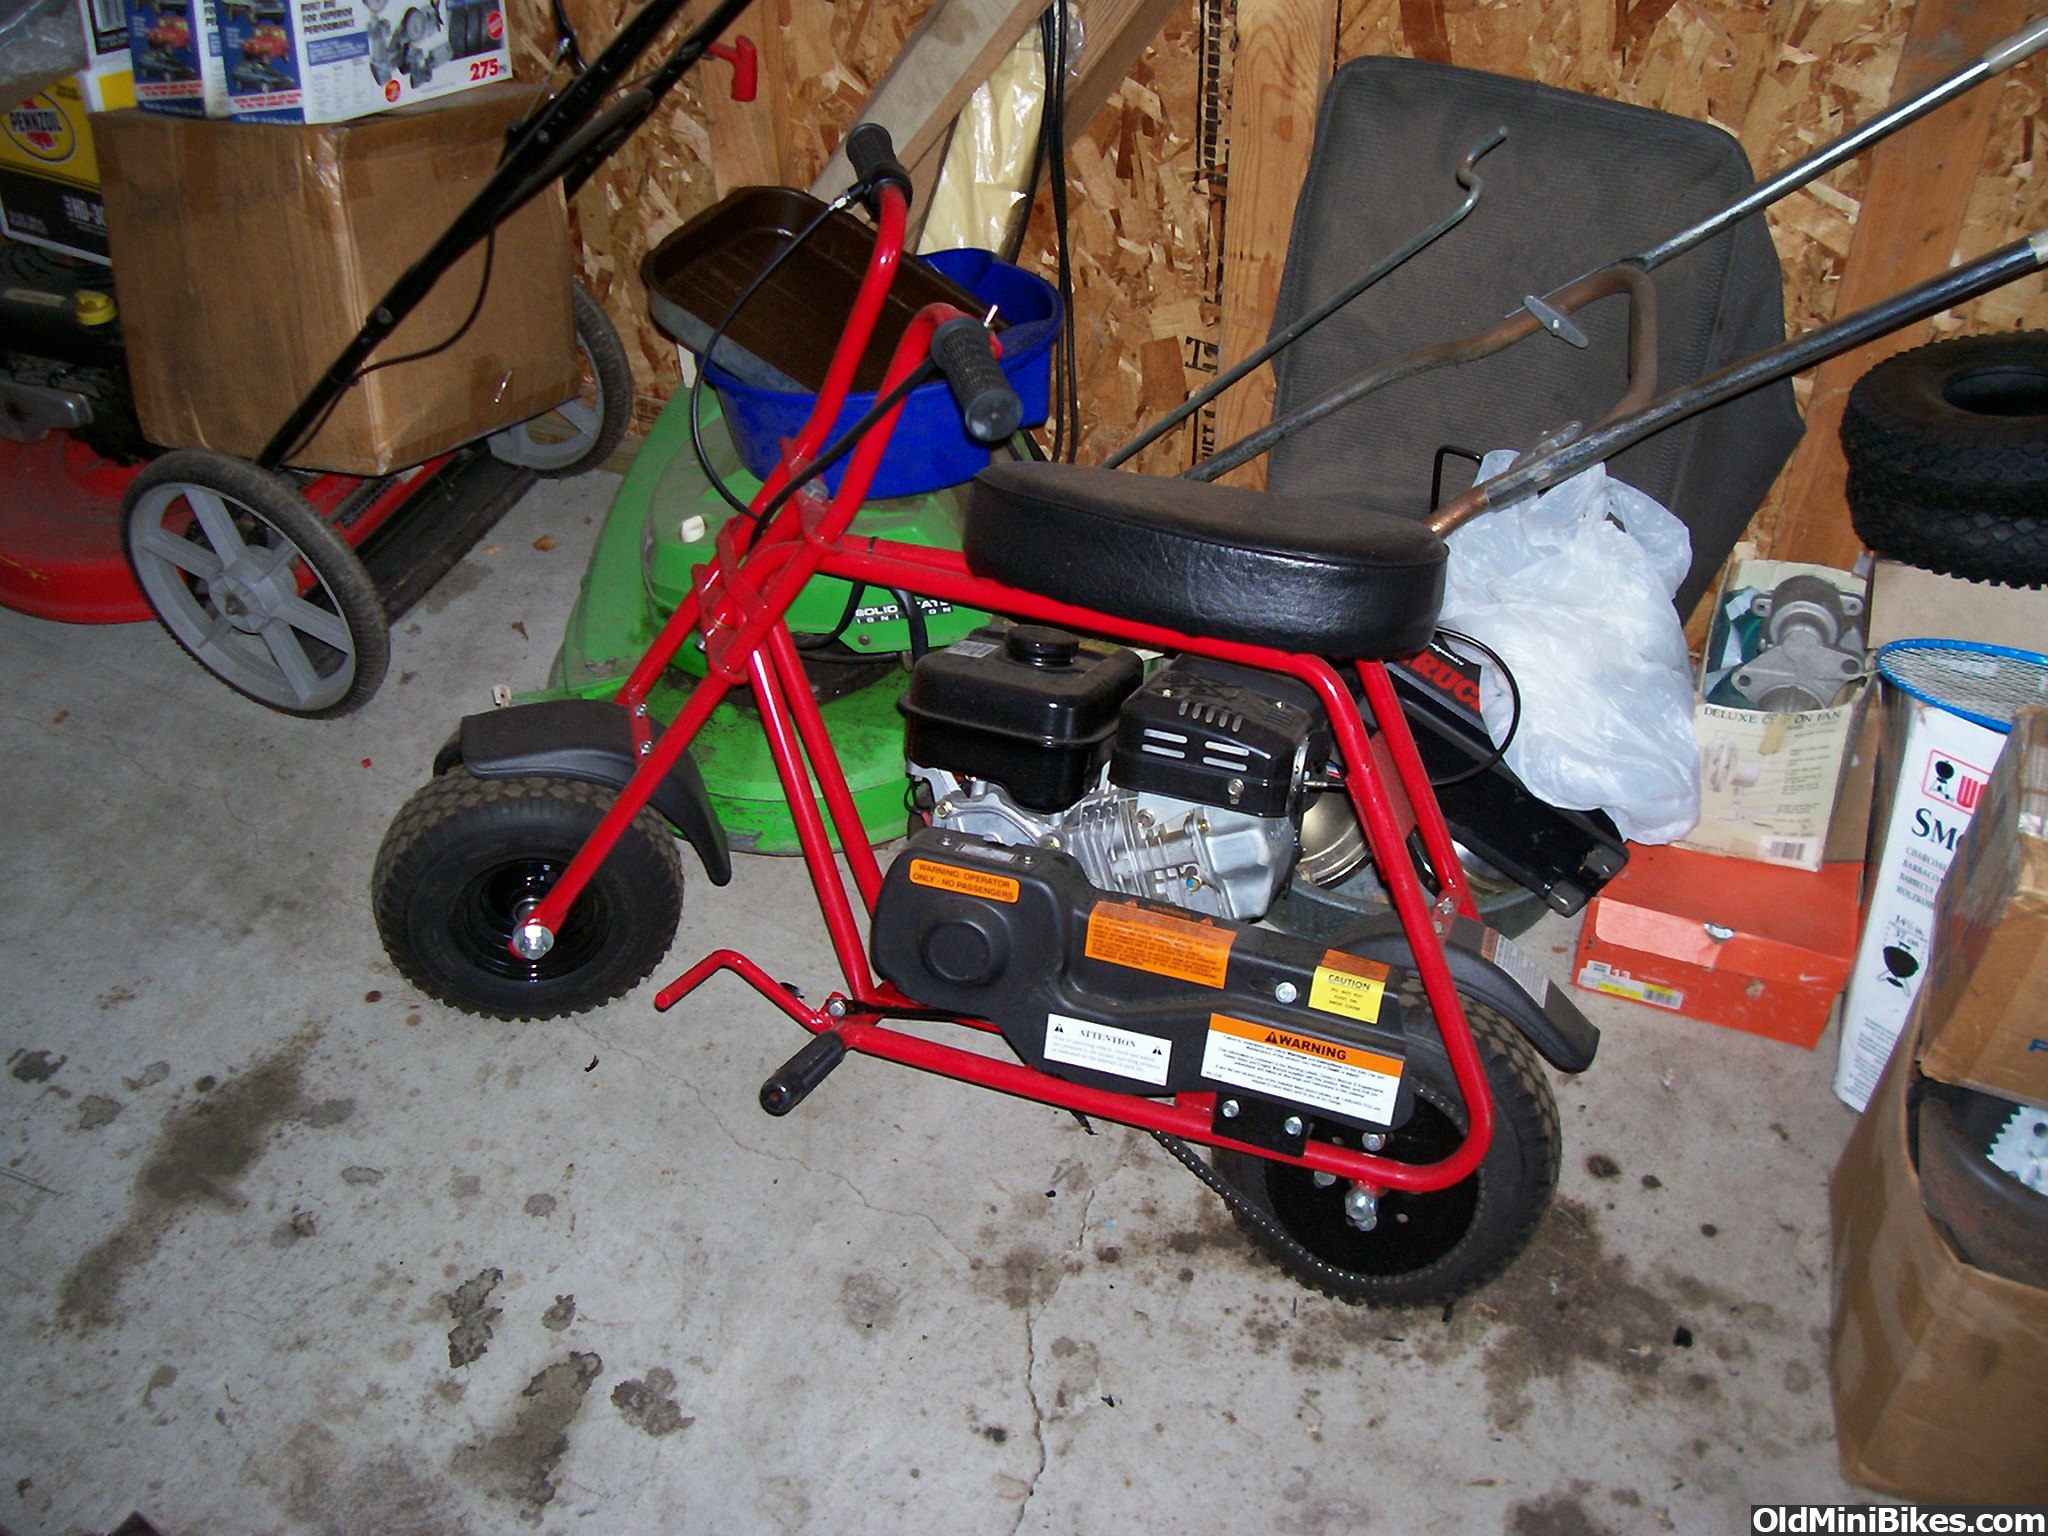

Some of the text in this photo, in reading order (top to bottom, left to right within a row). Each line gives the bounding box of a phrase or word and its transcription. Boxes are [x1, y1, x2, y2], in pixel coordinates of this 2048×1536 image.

[470, 58, 498, 81] 275
[9, 110, 64, 133] PENNZOIL
[855, 604, 899, 618] SOLID
[1704, 707, 1757, 724] DELUXE
[1816, 711, 1842, 722] FAN
[913, 873, 935, 883] ONLY
[942, 879, 955, 887] NO
[956, 881, 1014, 900] PASSENGERS
[963, 872, 1010, 888] OPERATOR
[1328, 974, 1371, 991] CAUTION
[1080, 1029, 1136, 1047] ATTENTION
[1279, 1034, 1347, 1060] WARNING
